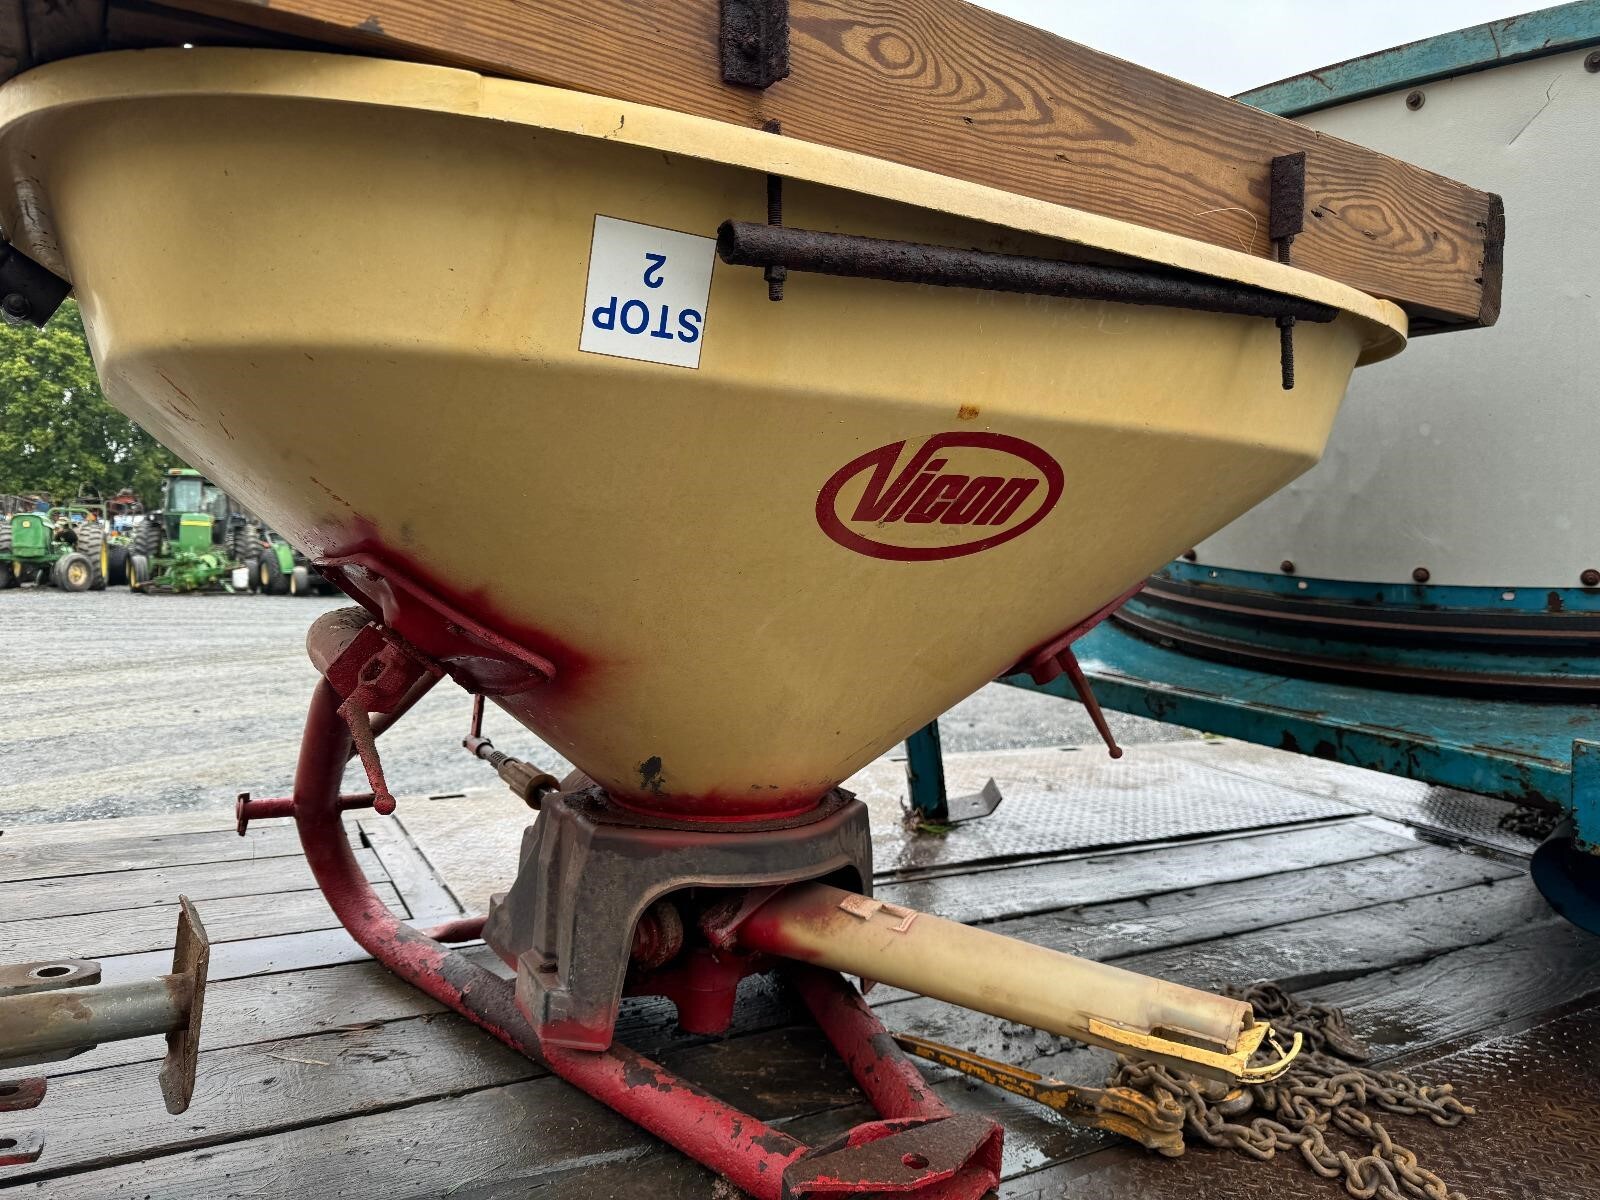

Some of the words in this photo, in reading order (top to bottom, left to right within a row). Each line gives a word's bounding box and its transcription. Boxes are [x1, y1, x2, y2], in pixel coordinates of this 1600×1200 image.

[643, 252, 667, 289] 2
[591, 296, 702, 344] STOP
[850, 435, 1041, 527] Vicon
